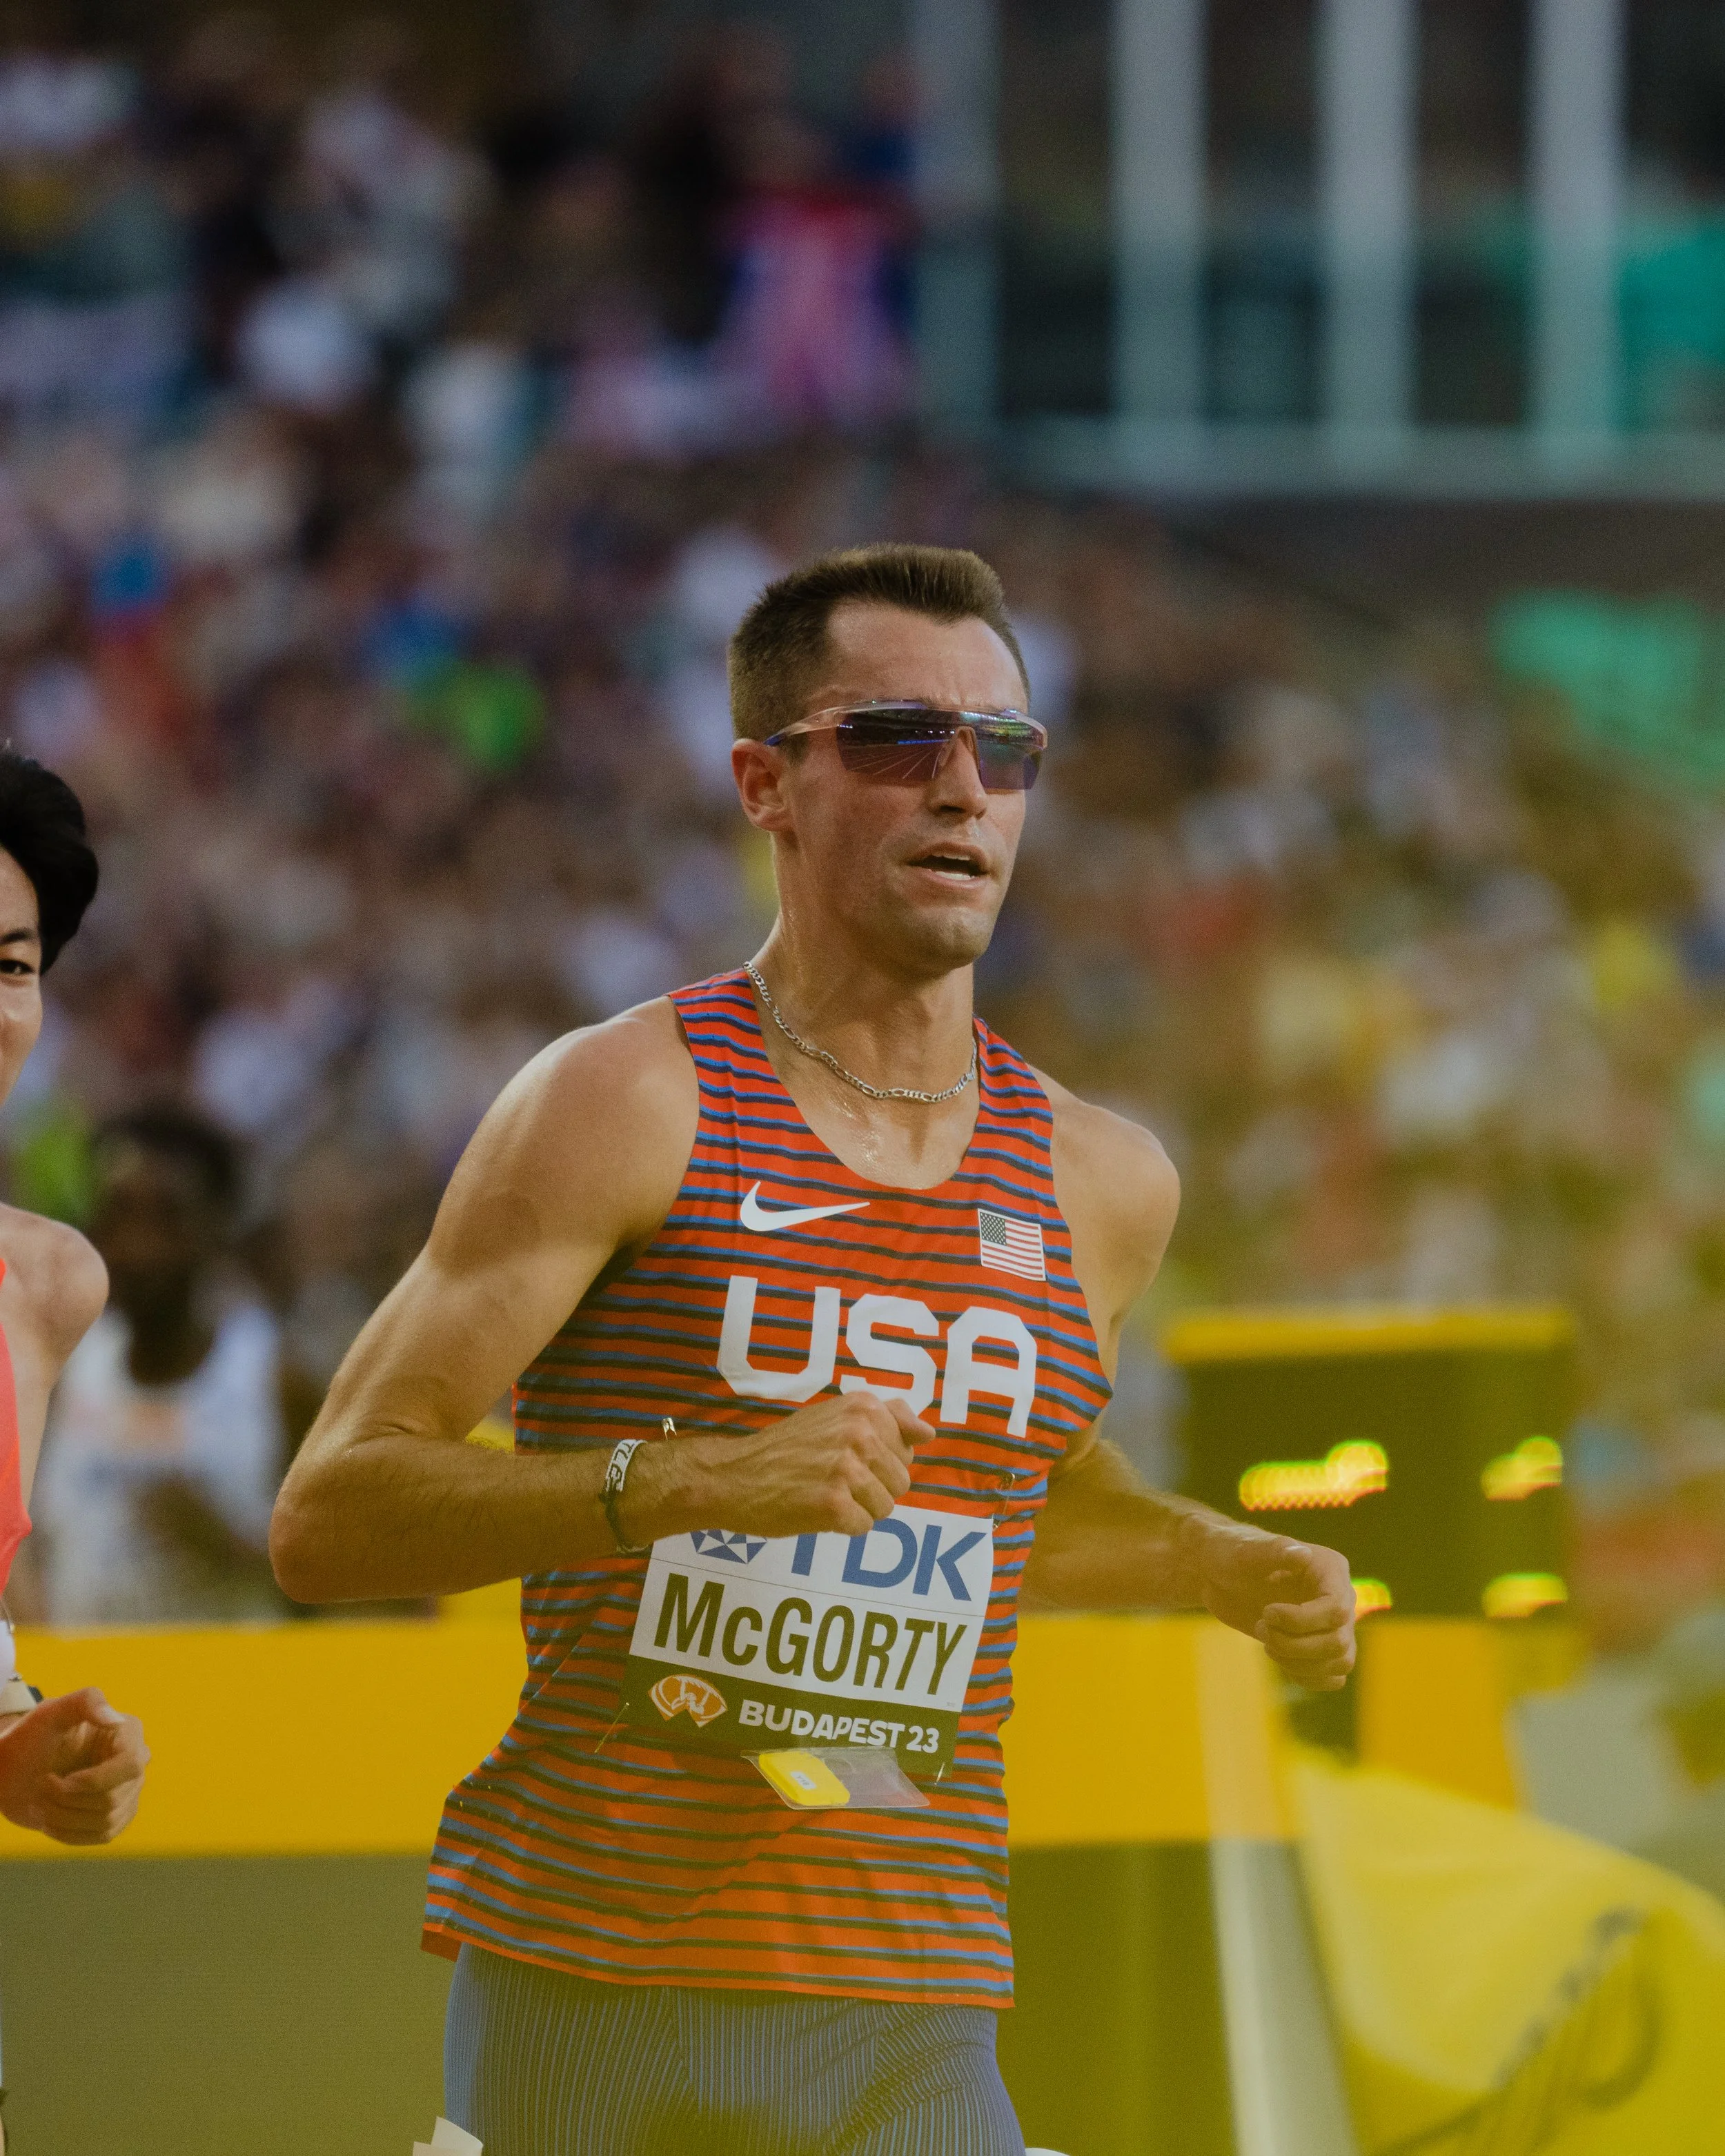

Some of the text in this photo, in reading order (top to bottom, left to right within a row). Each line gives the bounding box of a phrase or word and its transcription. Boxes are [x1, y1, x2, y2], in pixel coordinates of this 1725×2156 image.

[717, 1275, 1037, 1438] USA
[653, 1572, 967, 1696] McGORTY
[738, 1699, 940, 1754] BUDAPEST 23
